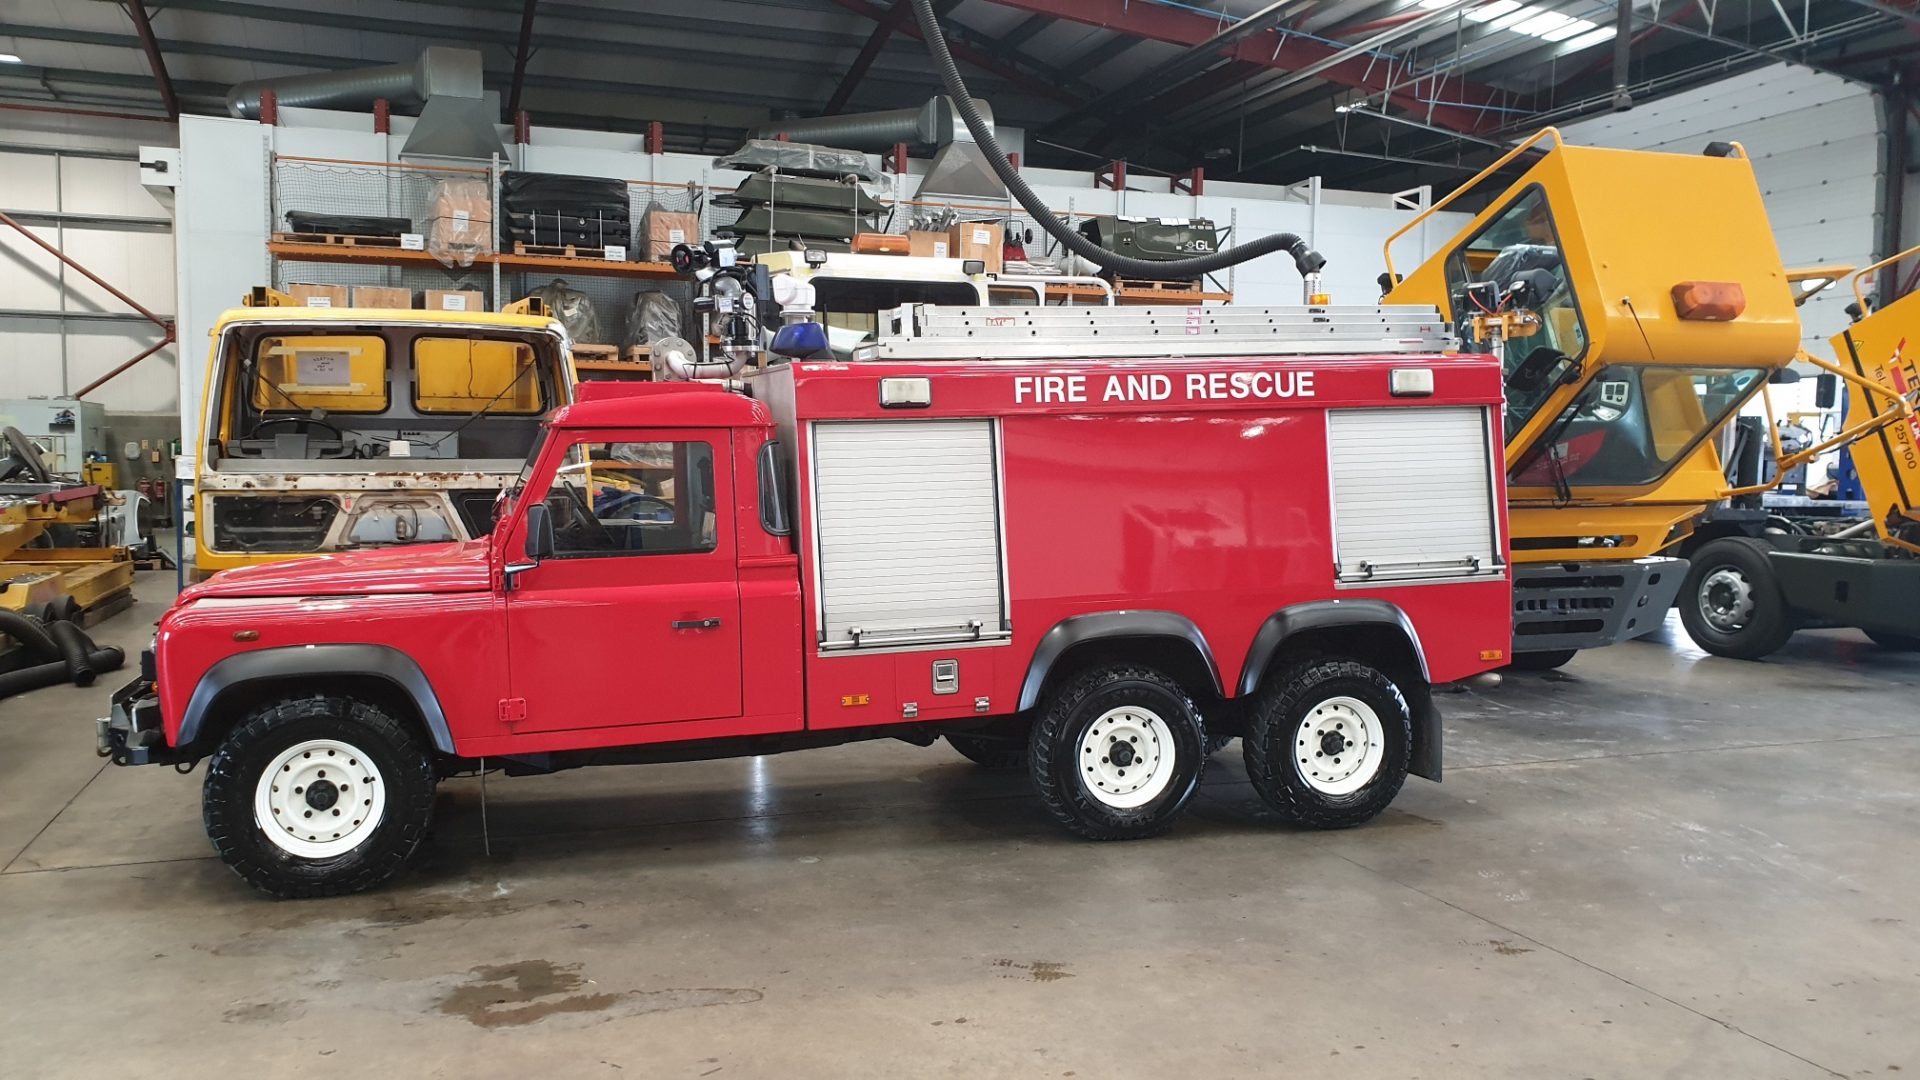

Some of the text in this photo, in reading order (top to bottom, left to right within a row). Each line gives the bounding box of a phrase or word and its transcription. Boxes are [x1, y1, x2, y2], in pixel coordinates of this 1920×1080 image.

[1195, 239, 1214, 251] GL
[1014, 371, 1316, 403] FIRE AND RESCUE
[1894, 424, 1917, 470] 257100
